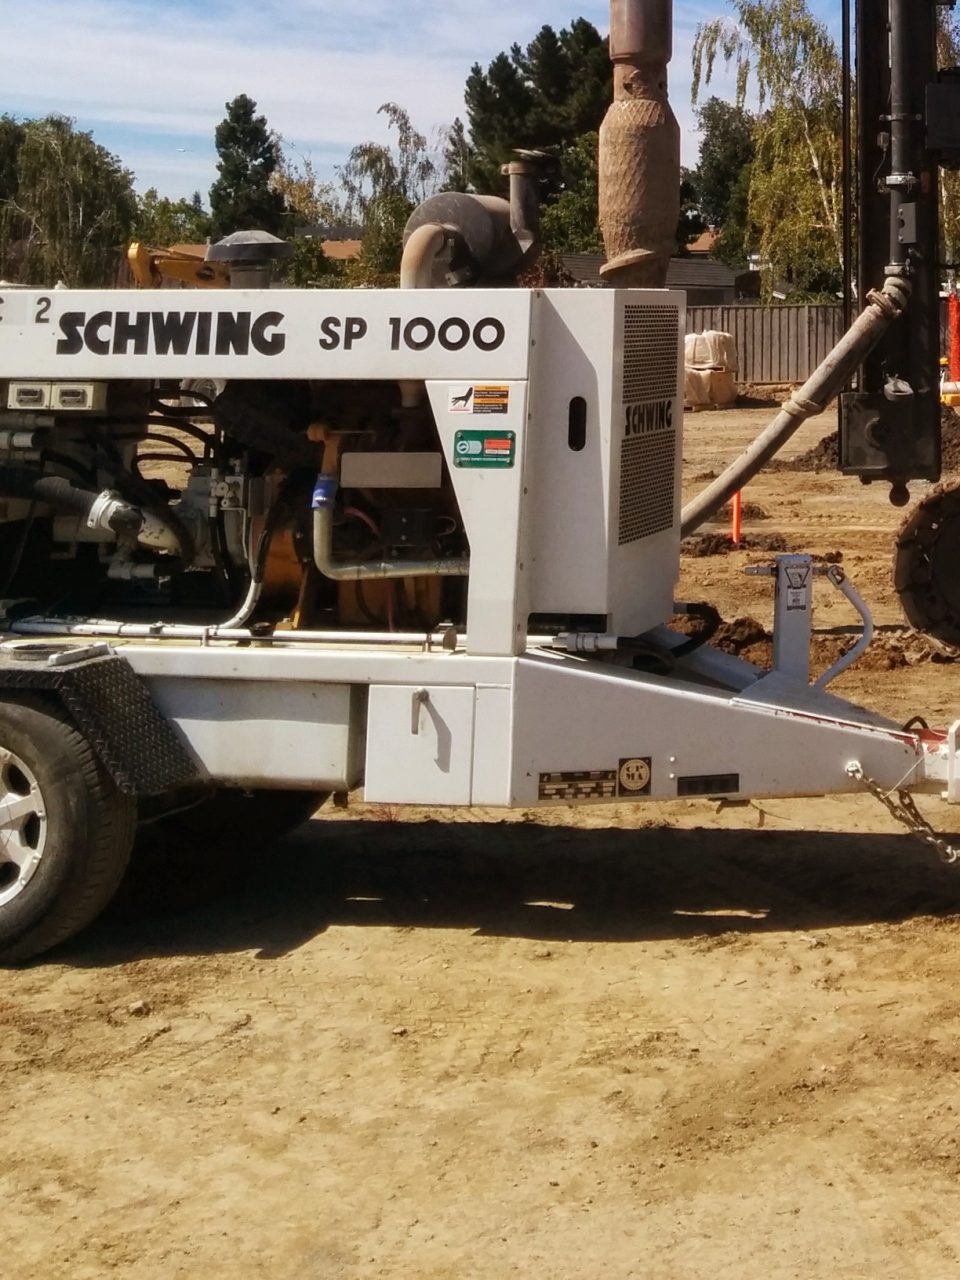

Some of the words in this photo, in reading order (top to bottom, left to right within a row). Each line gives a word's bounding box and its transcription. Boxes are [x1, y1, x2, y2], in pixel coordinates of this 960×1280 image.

[35, 296, 52, 323] 2
[56, 310, 286, 356] SCHWING
[319, 316, 367, 351] SP
[389, 317, 505, 351] 1000
[625, 400, 672, 436] SCHWING
